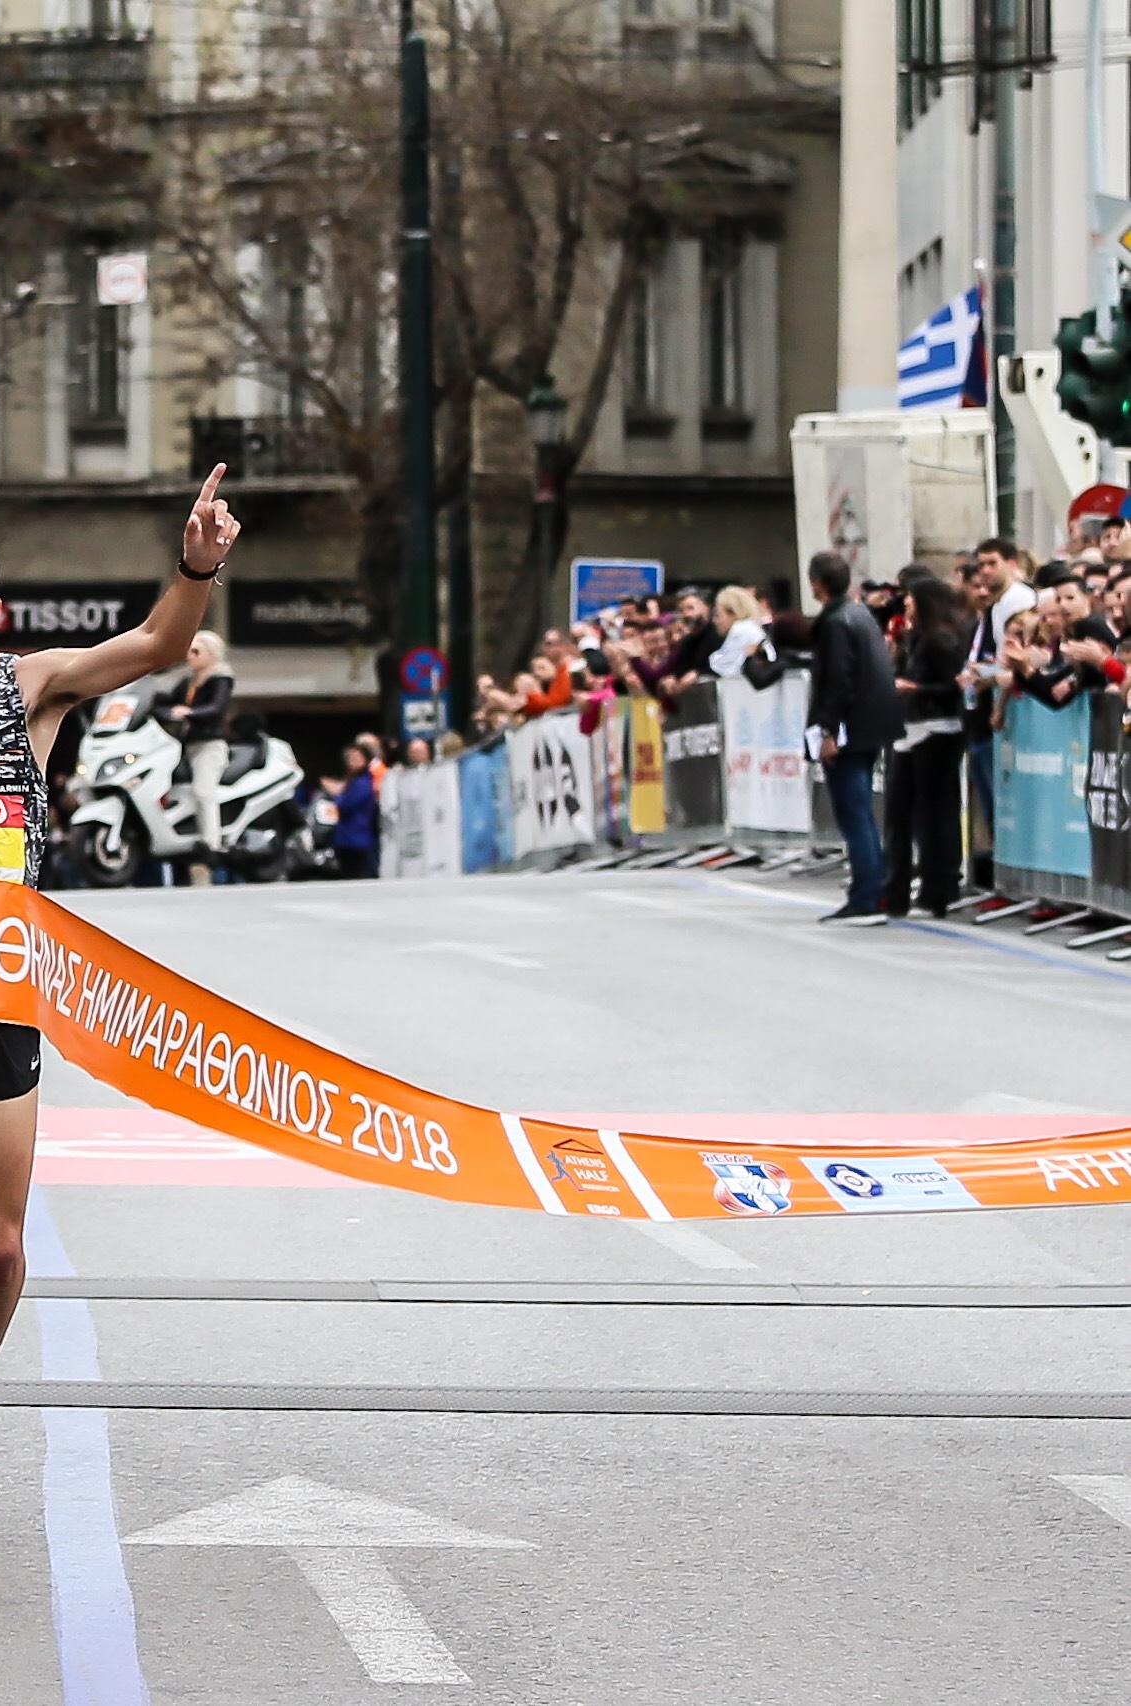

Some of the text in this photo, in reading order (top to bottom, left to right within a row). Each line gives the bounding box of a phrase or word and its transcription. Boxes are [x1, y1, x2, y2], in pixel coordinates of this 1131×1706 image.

[11, 601, 123, 631] TISSOT
[75, 962, 342, 1145] ΗΜΙΜΑΡΑΘΩΝΙΟΣ
[350, 1093, 459, 1175] 2018
[565, 1155, 606, 1168] ATHENS
[573, 1168, 608, 1182] HALF
[586, 1203, 621, 1215] ERGO
